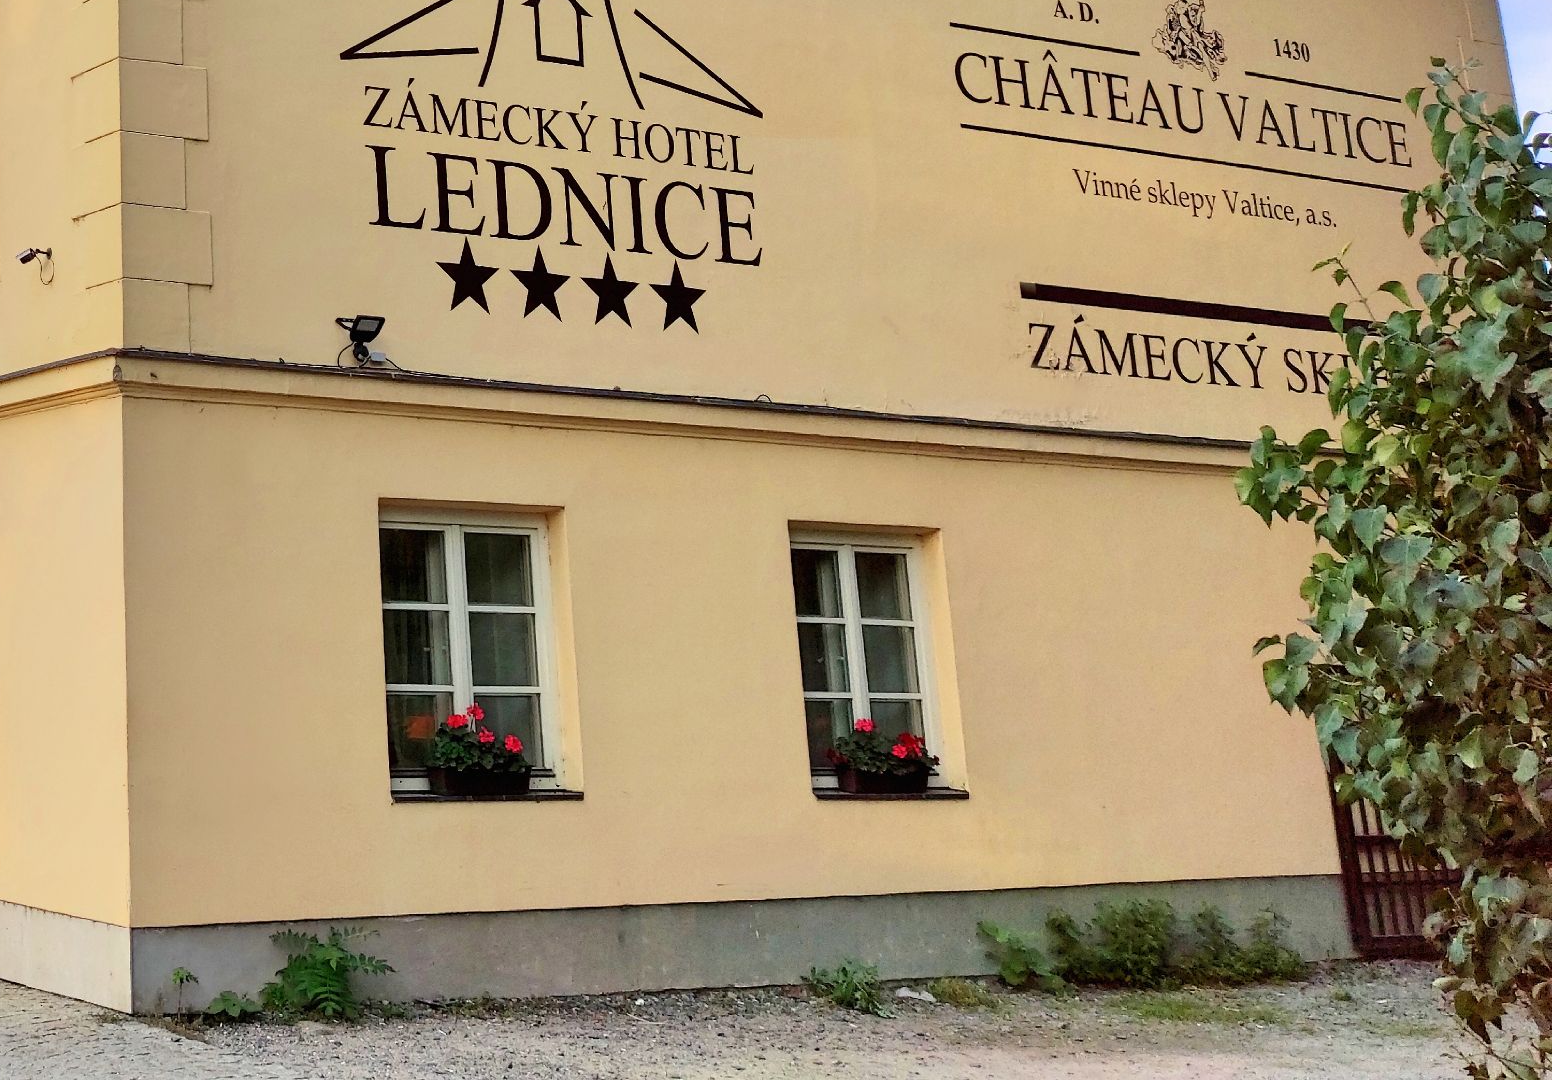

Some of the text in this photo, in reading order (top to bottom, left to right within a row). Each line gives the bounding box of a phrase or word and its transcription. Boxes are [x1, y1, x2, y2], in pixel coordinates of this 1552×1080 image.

[1079, 1, 1100, 24] D.
[1273, 38, 1311, 63] 1430
[363, 77, 755, 176] ZÁMECKÝ HOTEL
[954, 50, 1413, 168] CHÂTEAU VALTICE
[365, 144, 764, 268] LEDNICE
[1072, 168, 1339, 228] Vinné sklepy Valtice, a.s.
[1027, 314, 1268, 390] ZÁMECKÝ
